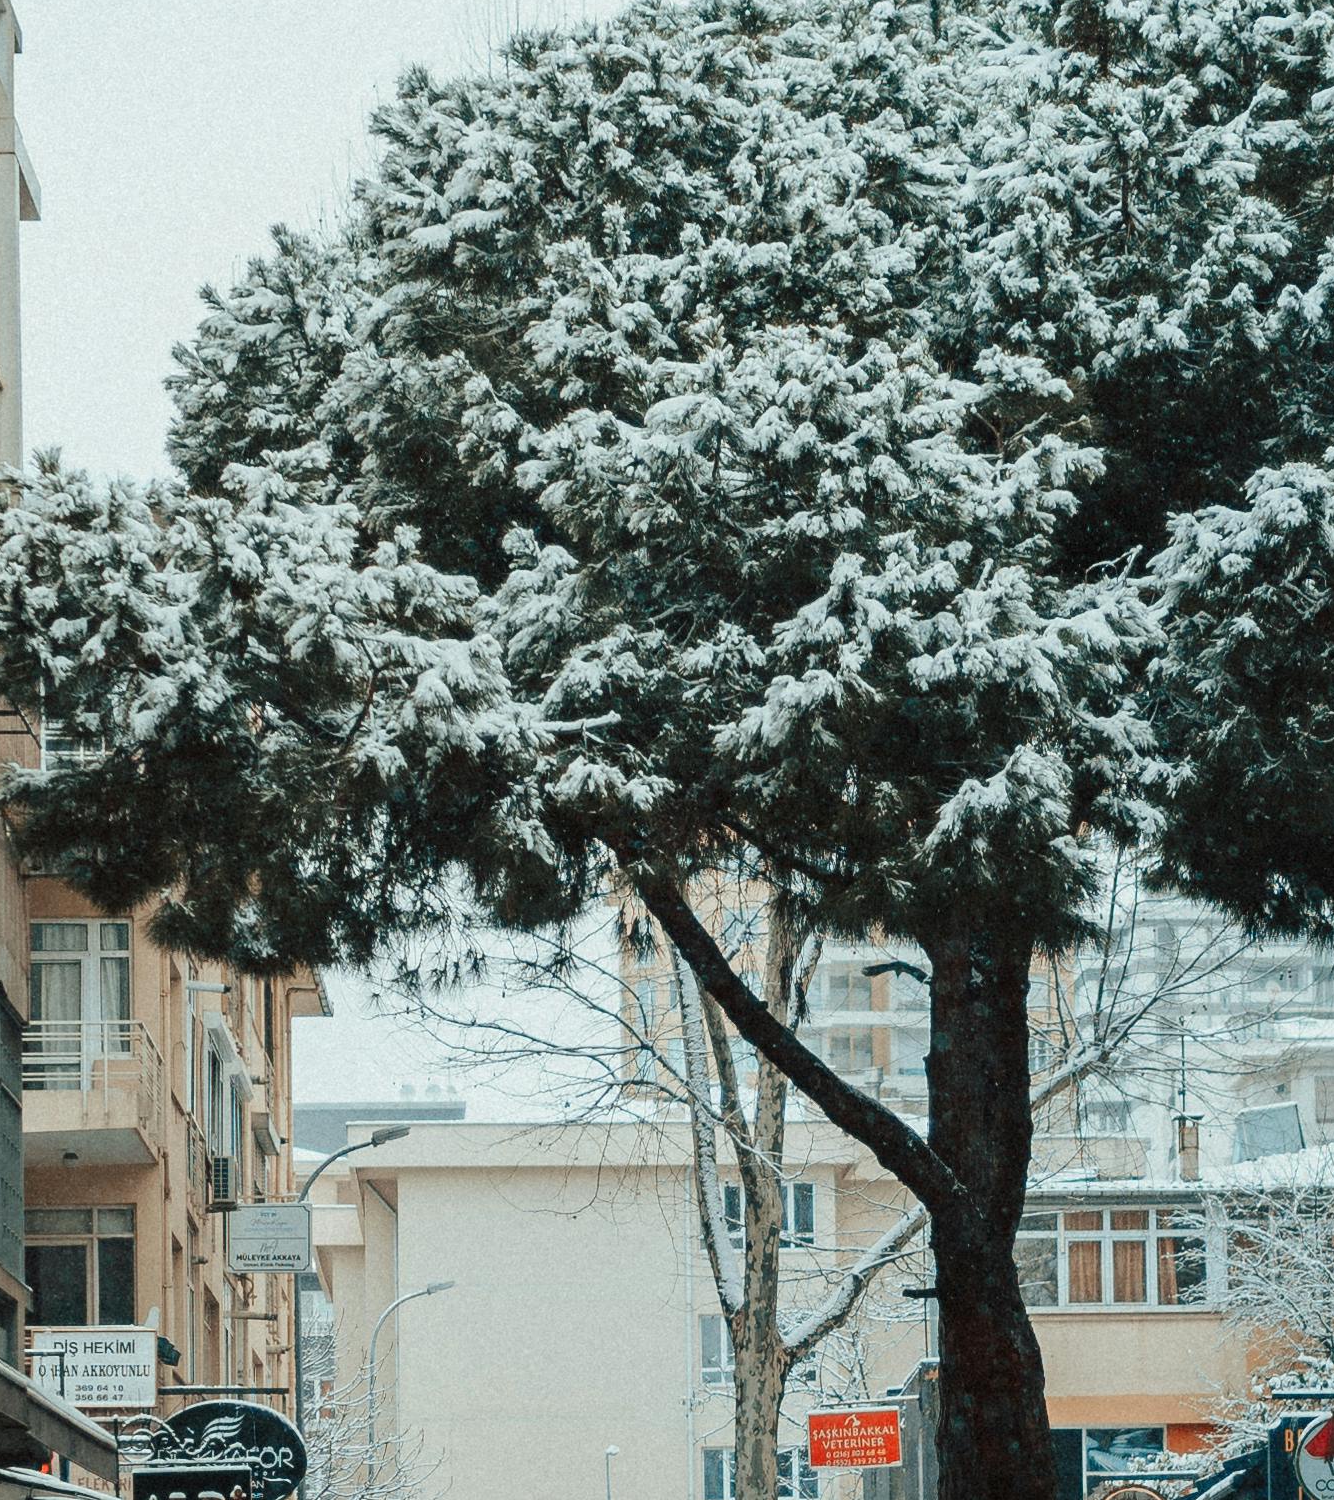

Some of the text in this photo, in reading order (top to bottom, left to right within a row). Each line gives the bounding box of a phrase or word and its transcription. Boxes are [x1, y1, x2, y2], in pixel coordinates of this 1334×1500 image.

[83, 1339, 135, 1355] HEKİMİ
[82, 1364, 151, 1378] AKKOYUNLU
[822, 1437, 886, 1450] VETERİNER
